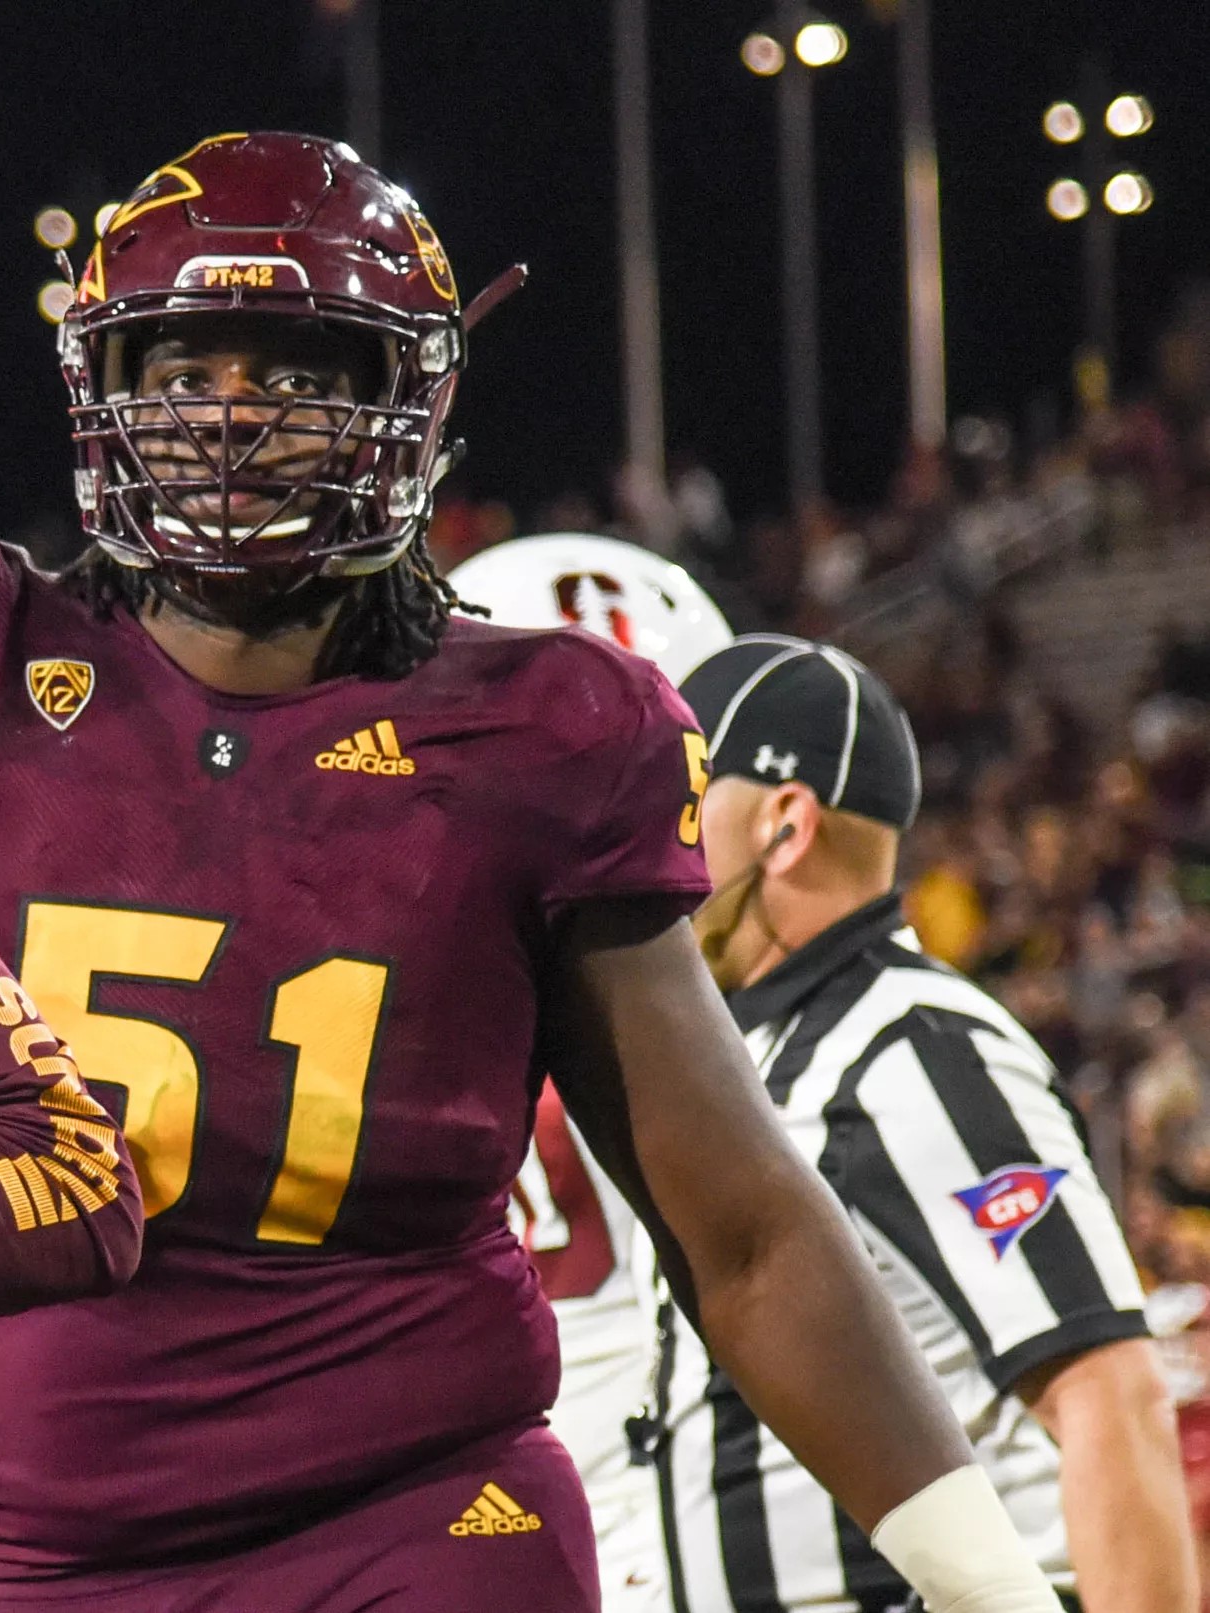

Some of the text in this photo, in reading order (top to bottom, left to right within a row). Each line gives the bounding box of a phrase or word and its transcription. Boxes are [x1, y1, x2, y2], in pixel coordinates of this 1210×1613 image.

[30, 661, 90, 701] PAC
[45, 686, 76, 713] 12
[315, 750, 415, 775] adidas
[20, 900, 390, 1247] 51
[448, 1513, 542, 1536] adidas
